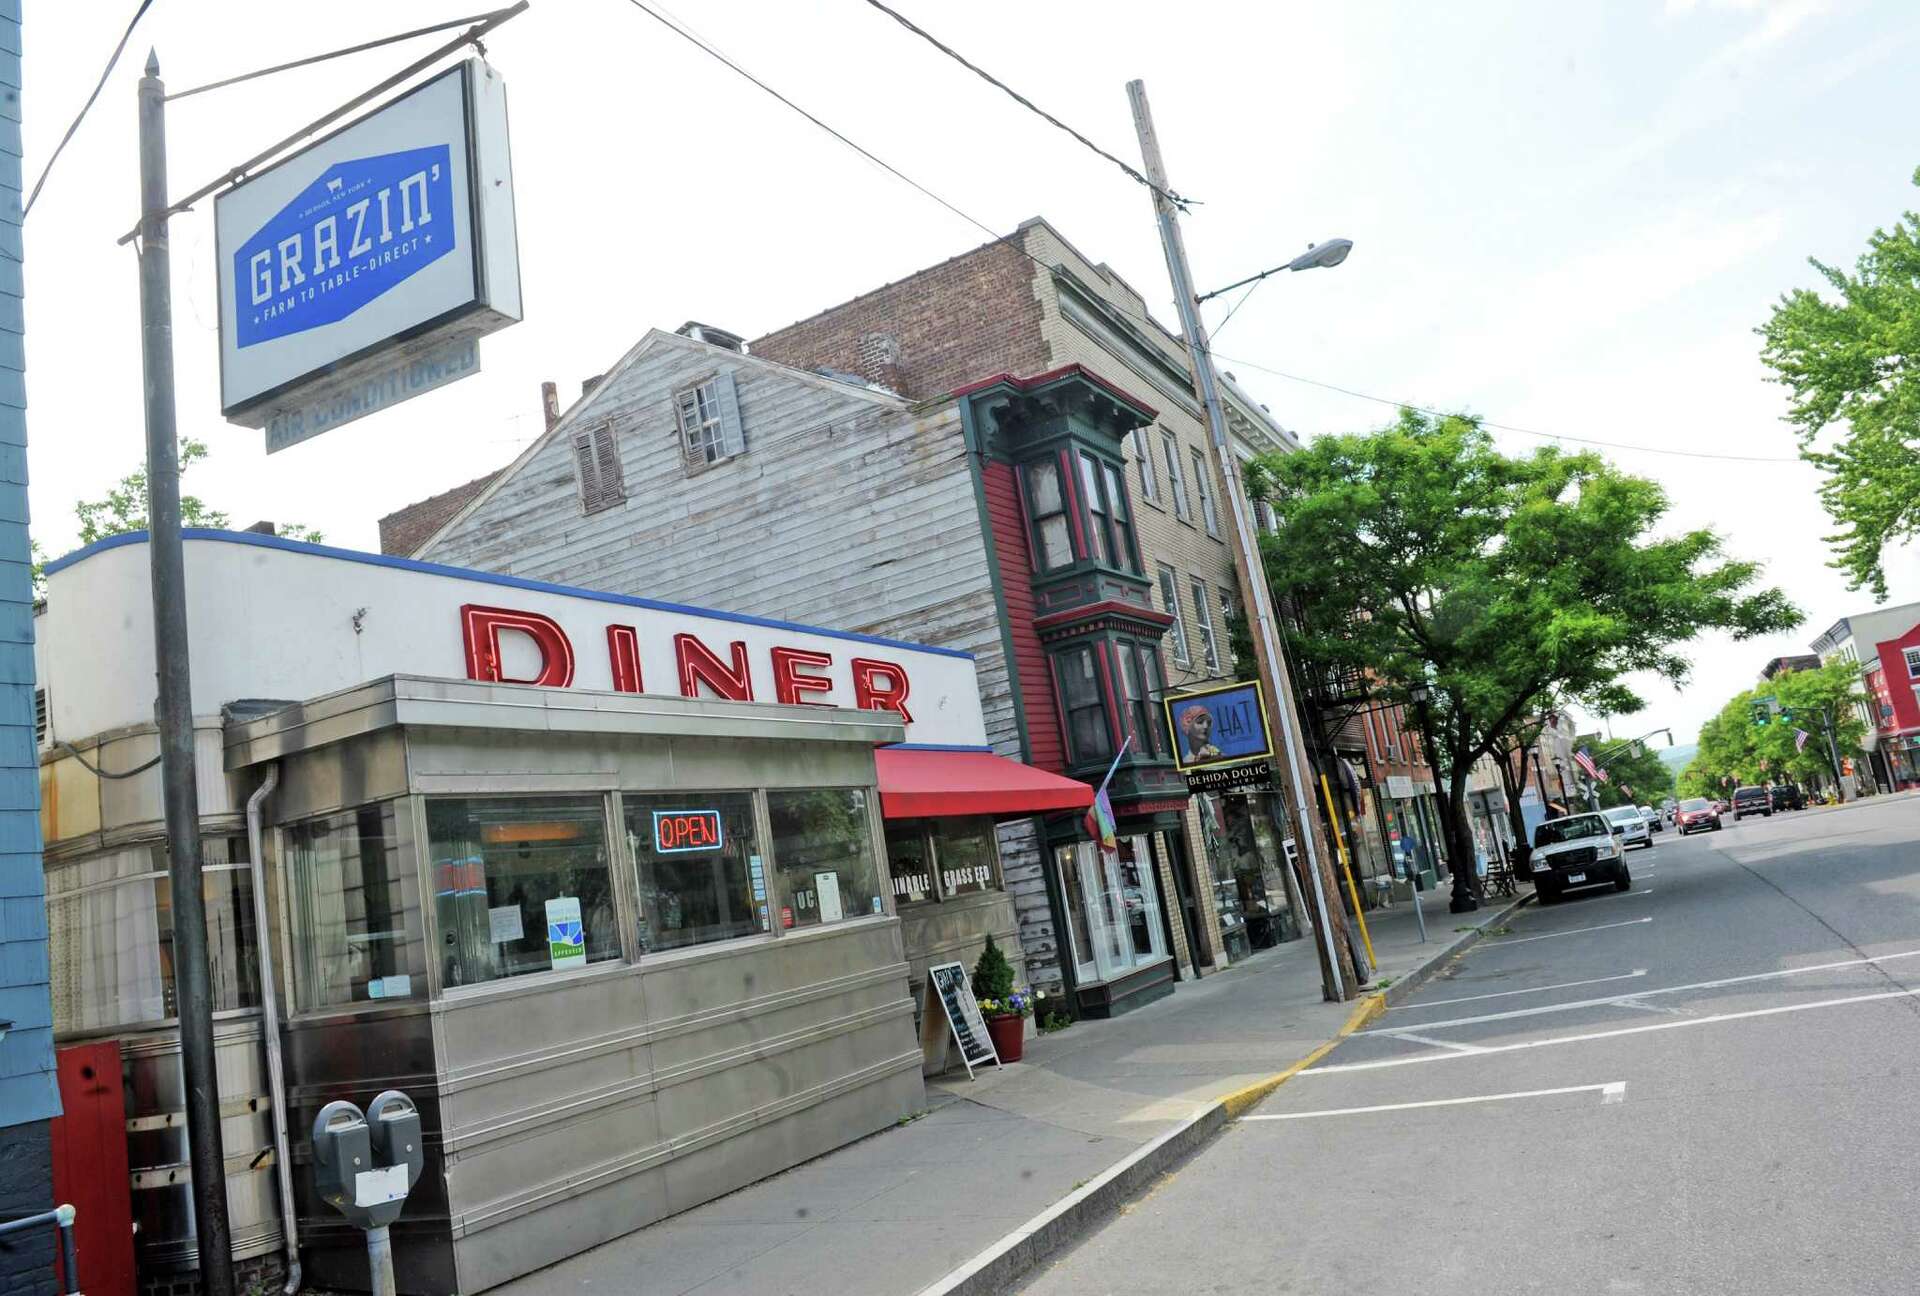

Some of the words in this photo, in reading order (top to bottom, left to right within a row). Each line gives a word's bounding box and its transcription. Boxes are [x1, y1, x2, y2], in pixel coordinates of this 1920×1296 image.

[263, 296, 296, 321] FARM
[301, 287, 315, 303] TO
[320, 237, 419, 295] TABLE-DIRECT
[270, 408, 305, 447] AIR
[460, 603, 914, 723] DINER
[1216, 700, 1252, 738] HAT
[1188, 771, 1229, 786] BEHIDA
[1231, 764, 1268, 779] DOLIC
[660, 815, 717, 848] OPEN
[943, 867, 974, 888] GRASS
